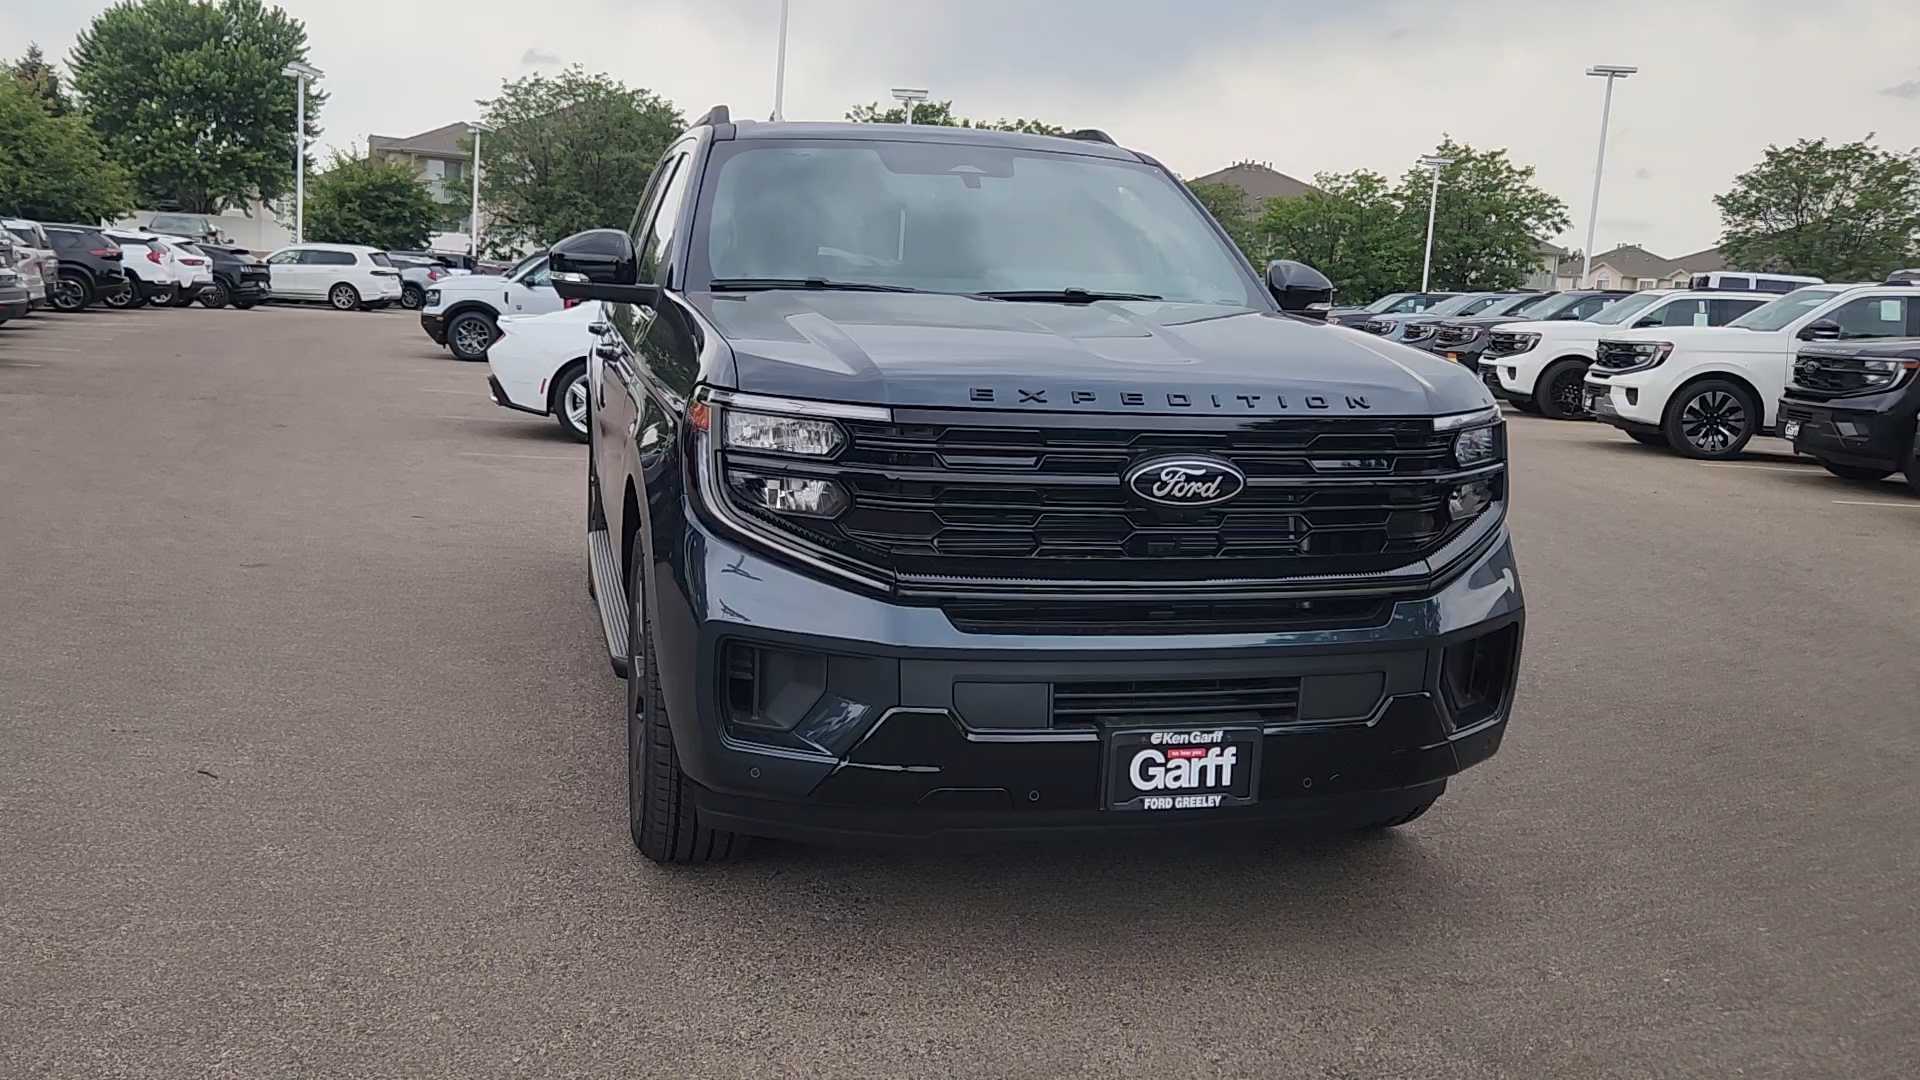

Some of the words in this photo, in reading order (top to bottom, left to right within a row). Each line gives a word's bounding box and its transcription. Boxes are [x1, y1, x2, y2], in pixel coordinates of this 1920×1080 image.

[969, 387, 1371, 410] EXPEDITION
[1153, 467, 1223, 498] Ford
[1163, 732, 1189, 744] Ken
[1190, 731, 1223, 743] Garff
[1130, 747, 1236, 791] Garff
[1144, 797, 1172, 809] FORD
[1175, 796, 1221, 808] GREELEY
